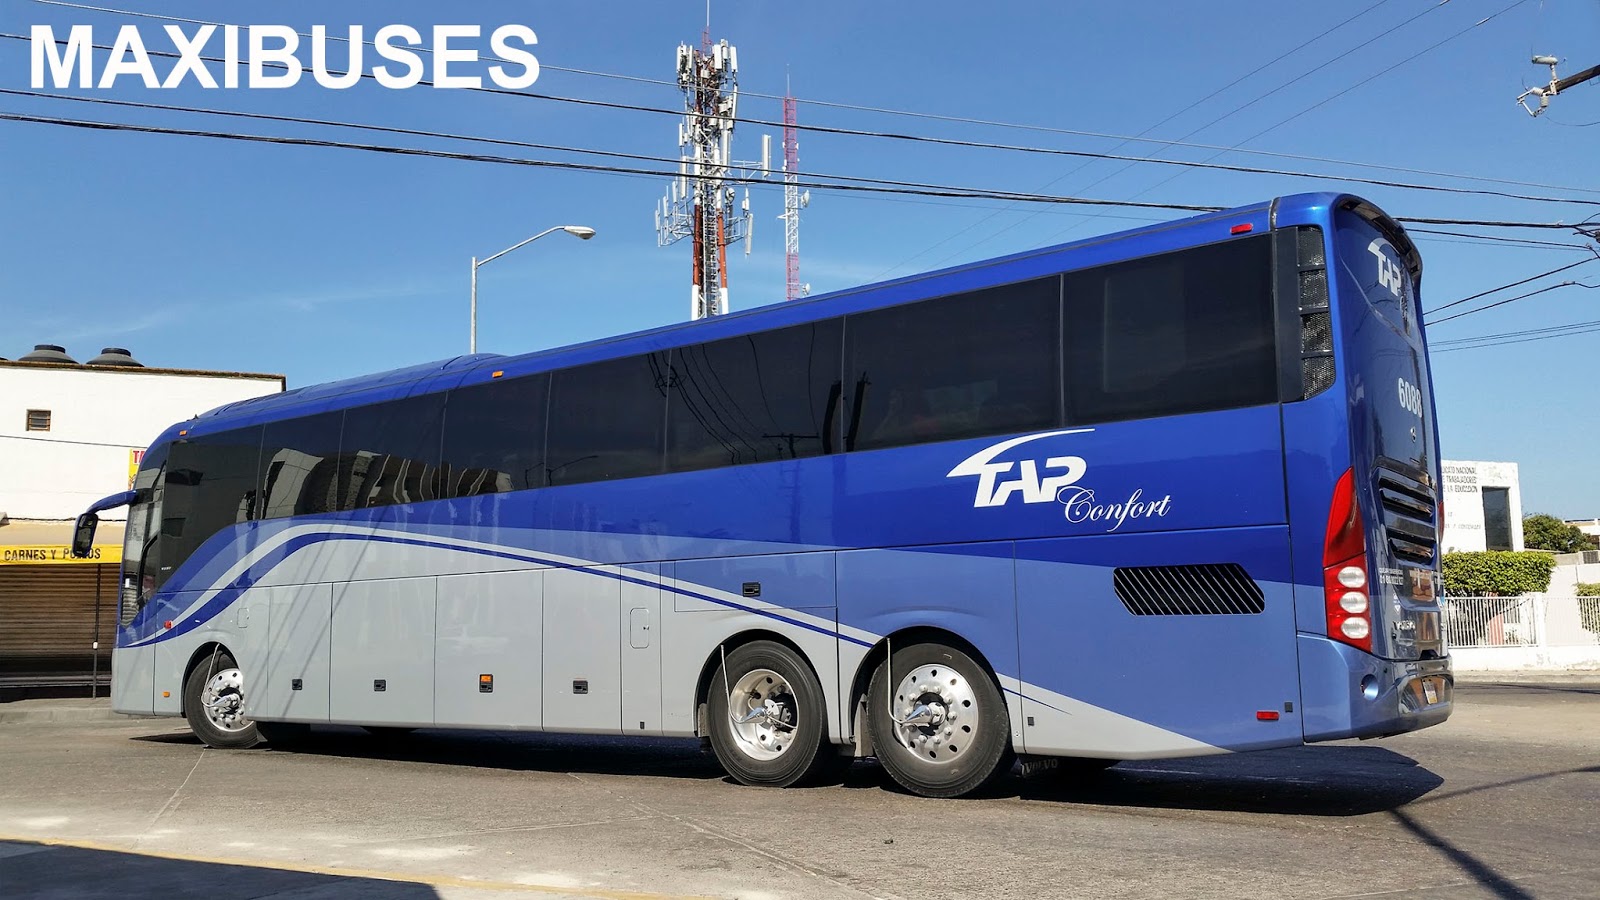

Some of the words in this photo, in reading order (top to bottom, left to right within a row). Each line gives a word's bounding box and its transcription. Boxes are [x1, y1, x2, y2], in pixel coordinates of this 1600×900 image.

[1368, 243, 1402, 296] TAP
[1398, 377, 1422, 418] 6088
[946, 456, 1087, 508] TAP
[1057, 486, 1171, 532] Confort
[5, 550, 46, 561] CARNES
[51, 550, 57, 560] Y
